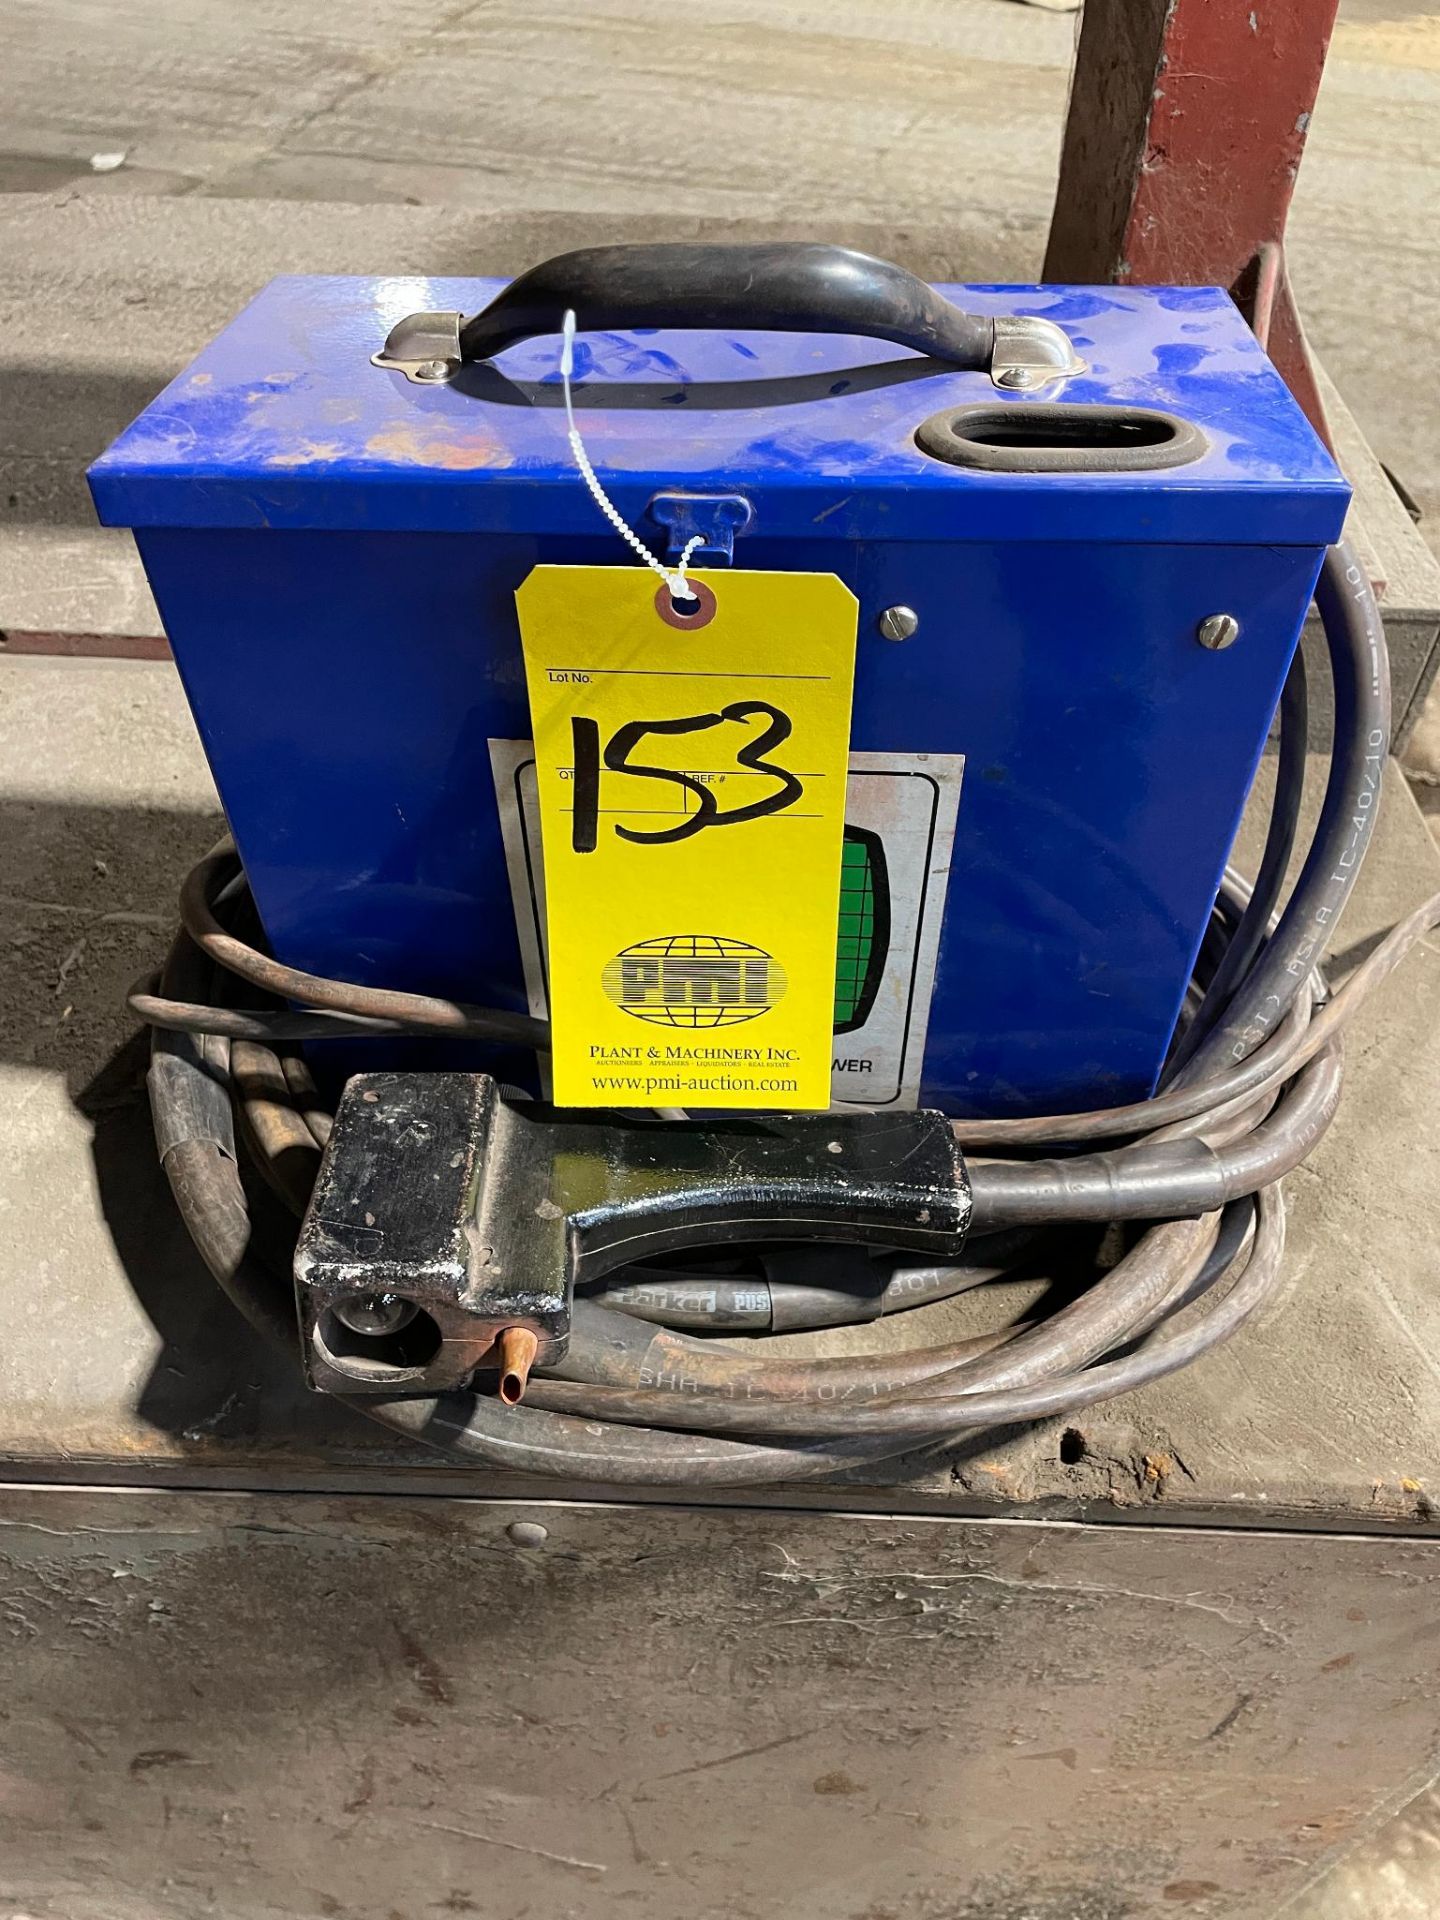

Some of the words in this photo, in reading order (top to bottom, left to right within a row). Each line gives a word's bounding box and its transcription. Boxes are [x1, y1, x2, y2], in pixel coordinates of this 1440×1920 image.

[548, 672, 569, 683] Lot
[571, 672, 593, 684] No.
[570, 700, 804, 854] 153
[692, 774, 718, 784] REF.
[1330, 728, 1383, 883] IC-40/10
[589, 1045, 643, 1058] PLANT
[646, 1046, 661, 1059] &
[665, 1046, 763, 1061] MACHINERY
[766, 1047, 801, 1061] INC.
[831, 1058, 873, 1073] WER
[591, 1073, 798, 1095] www.pmi-auction.com
[732, 1290, 772, 1313] PUS
